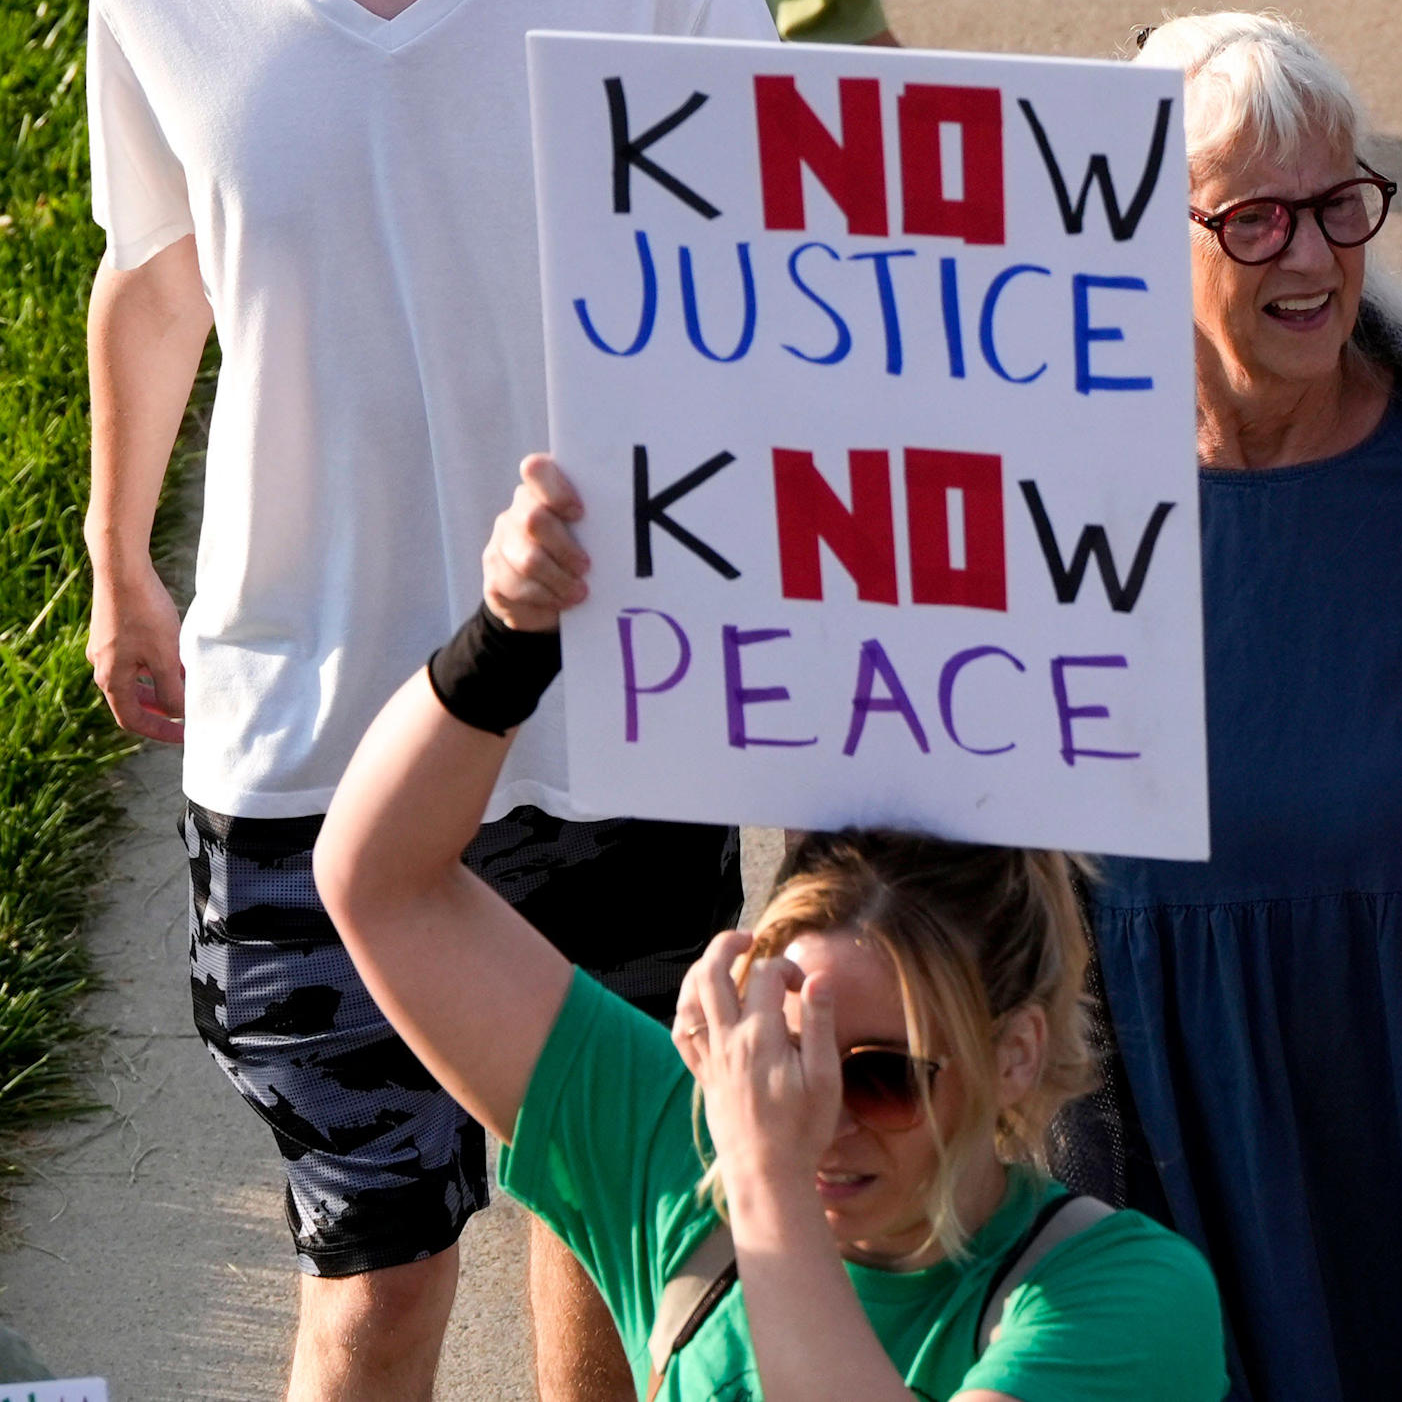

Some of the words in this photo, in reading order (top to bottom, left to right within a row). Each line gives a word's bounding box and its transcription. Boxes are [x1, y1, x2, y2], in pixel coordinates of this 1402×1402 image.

[602, 73, 1174, 246] KNOW
[572, 229, 1154, 395] JUSTICE
[633, 444, 1177, 613] KNOW
[616, 606, 1141, 766] PEACE
